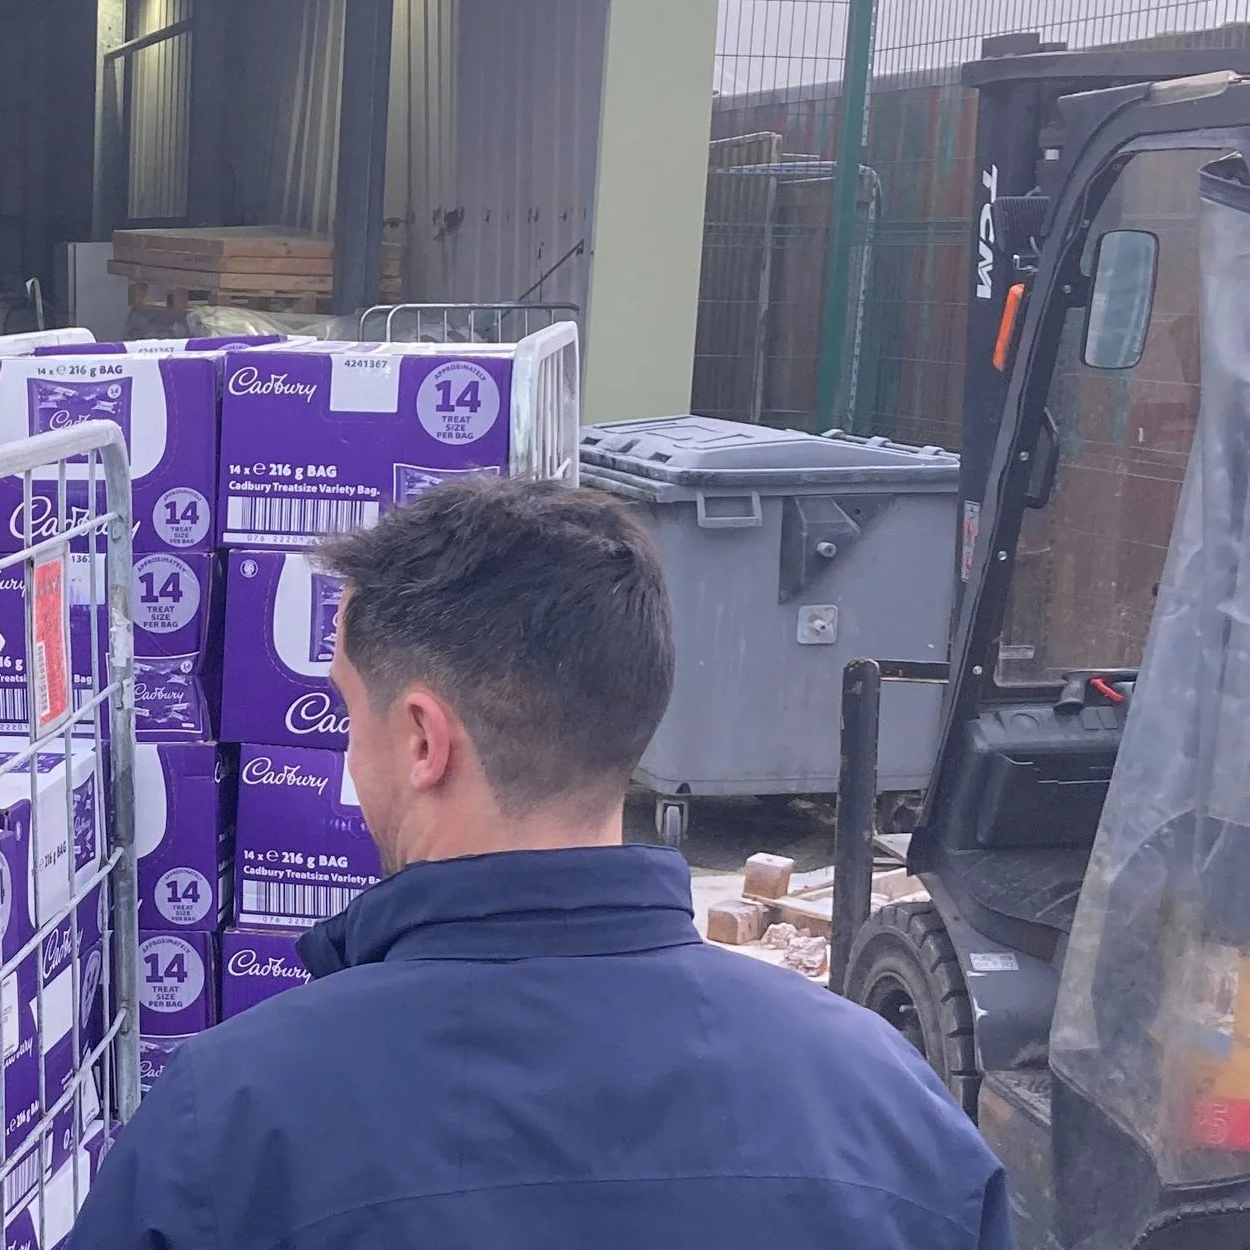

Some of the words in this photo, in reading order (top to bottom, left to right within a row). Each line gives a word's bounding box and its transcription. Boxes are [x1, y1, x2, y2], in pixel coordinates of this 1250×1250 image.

[976, 164, 998, 298] TCM
[69, 366, 86, 375] 216
[100, 365, 122, 374] BAG
[344, 359, 388, 368] 4241367
[228, 366, 318, 402] Cadbury
[434, 380, 481, 413] 14
[229, 464, 241, 474] 14
[268, 464, 291, 476] 216
[307, 465, 337, 478] BAG
[228, 481, 271, 494] Cadbury
[272, 482, 318, 493] Treatsize
[319, 484, 356, 496] Variety
[357, 485, 381, 497] Bag.
[164, 501, 199, 524] 14
[139, 572, 182, 603] 14
[134, 683, 184, 701] Cadbury
[242, 757, 329, 794] Cadbury
[282, 851, 304, 865] 216
[319, 854, 349, 868] BAG
[243, 865, 285, 879] Cadbury
[286, 870, 330, 882] Treatsize
[331, 872, 366, 885] Variety
[166, 880, 200, 903] 14
[143, 953, 188, 983] 14
[228, 949, 312, 984] Cadbury
